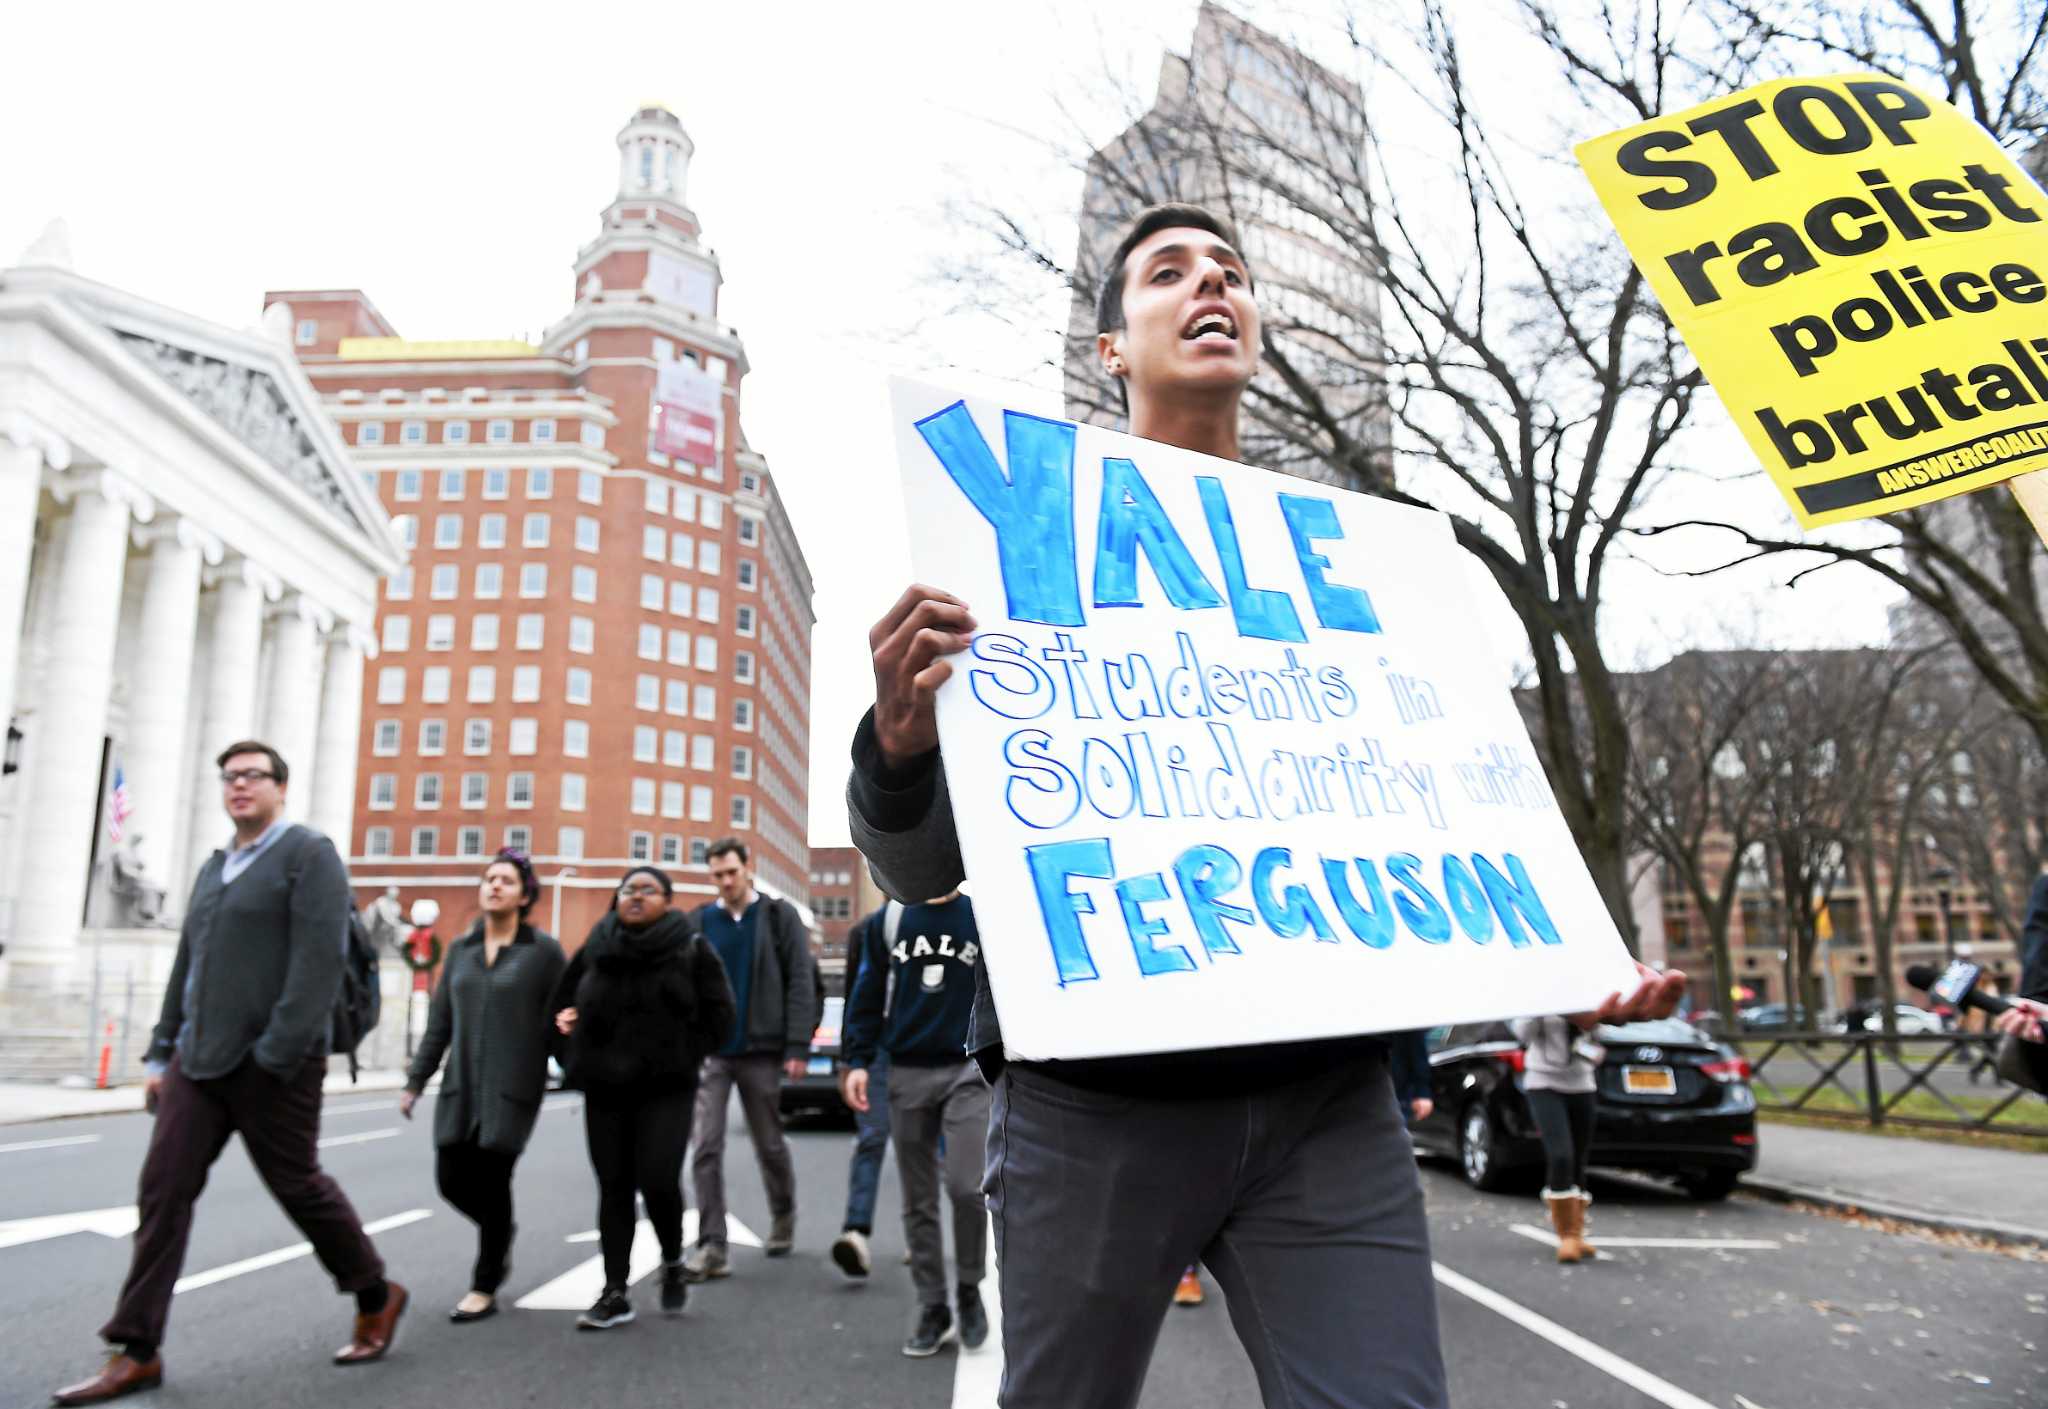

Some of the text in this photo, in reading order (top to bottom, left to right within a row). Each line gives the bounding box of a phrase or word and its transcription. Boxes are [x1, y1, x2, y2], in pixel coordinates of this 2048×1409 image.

[1616, 81, 1931, 211] STOP
[1664, 163, 2042, 307] racist
[1769, 262, 2048, 377] police
[914, 400, 1383, 643] YALE
[969, 631, 1444, 724] Students in
[1452, 742, 1552, 808] with
